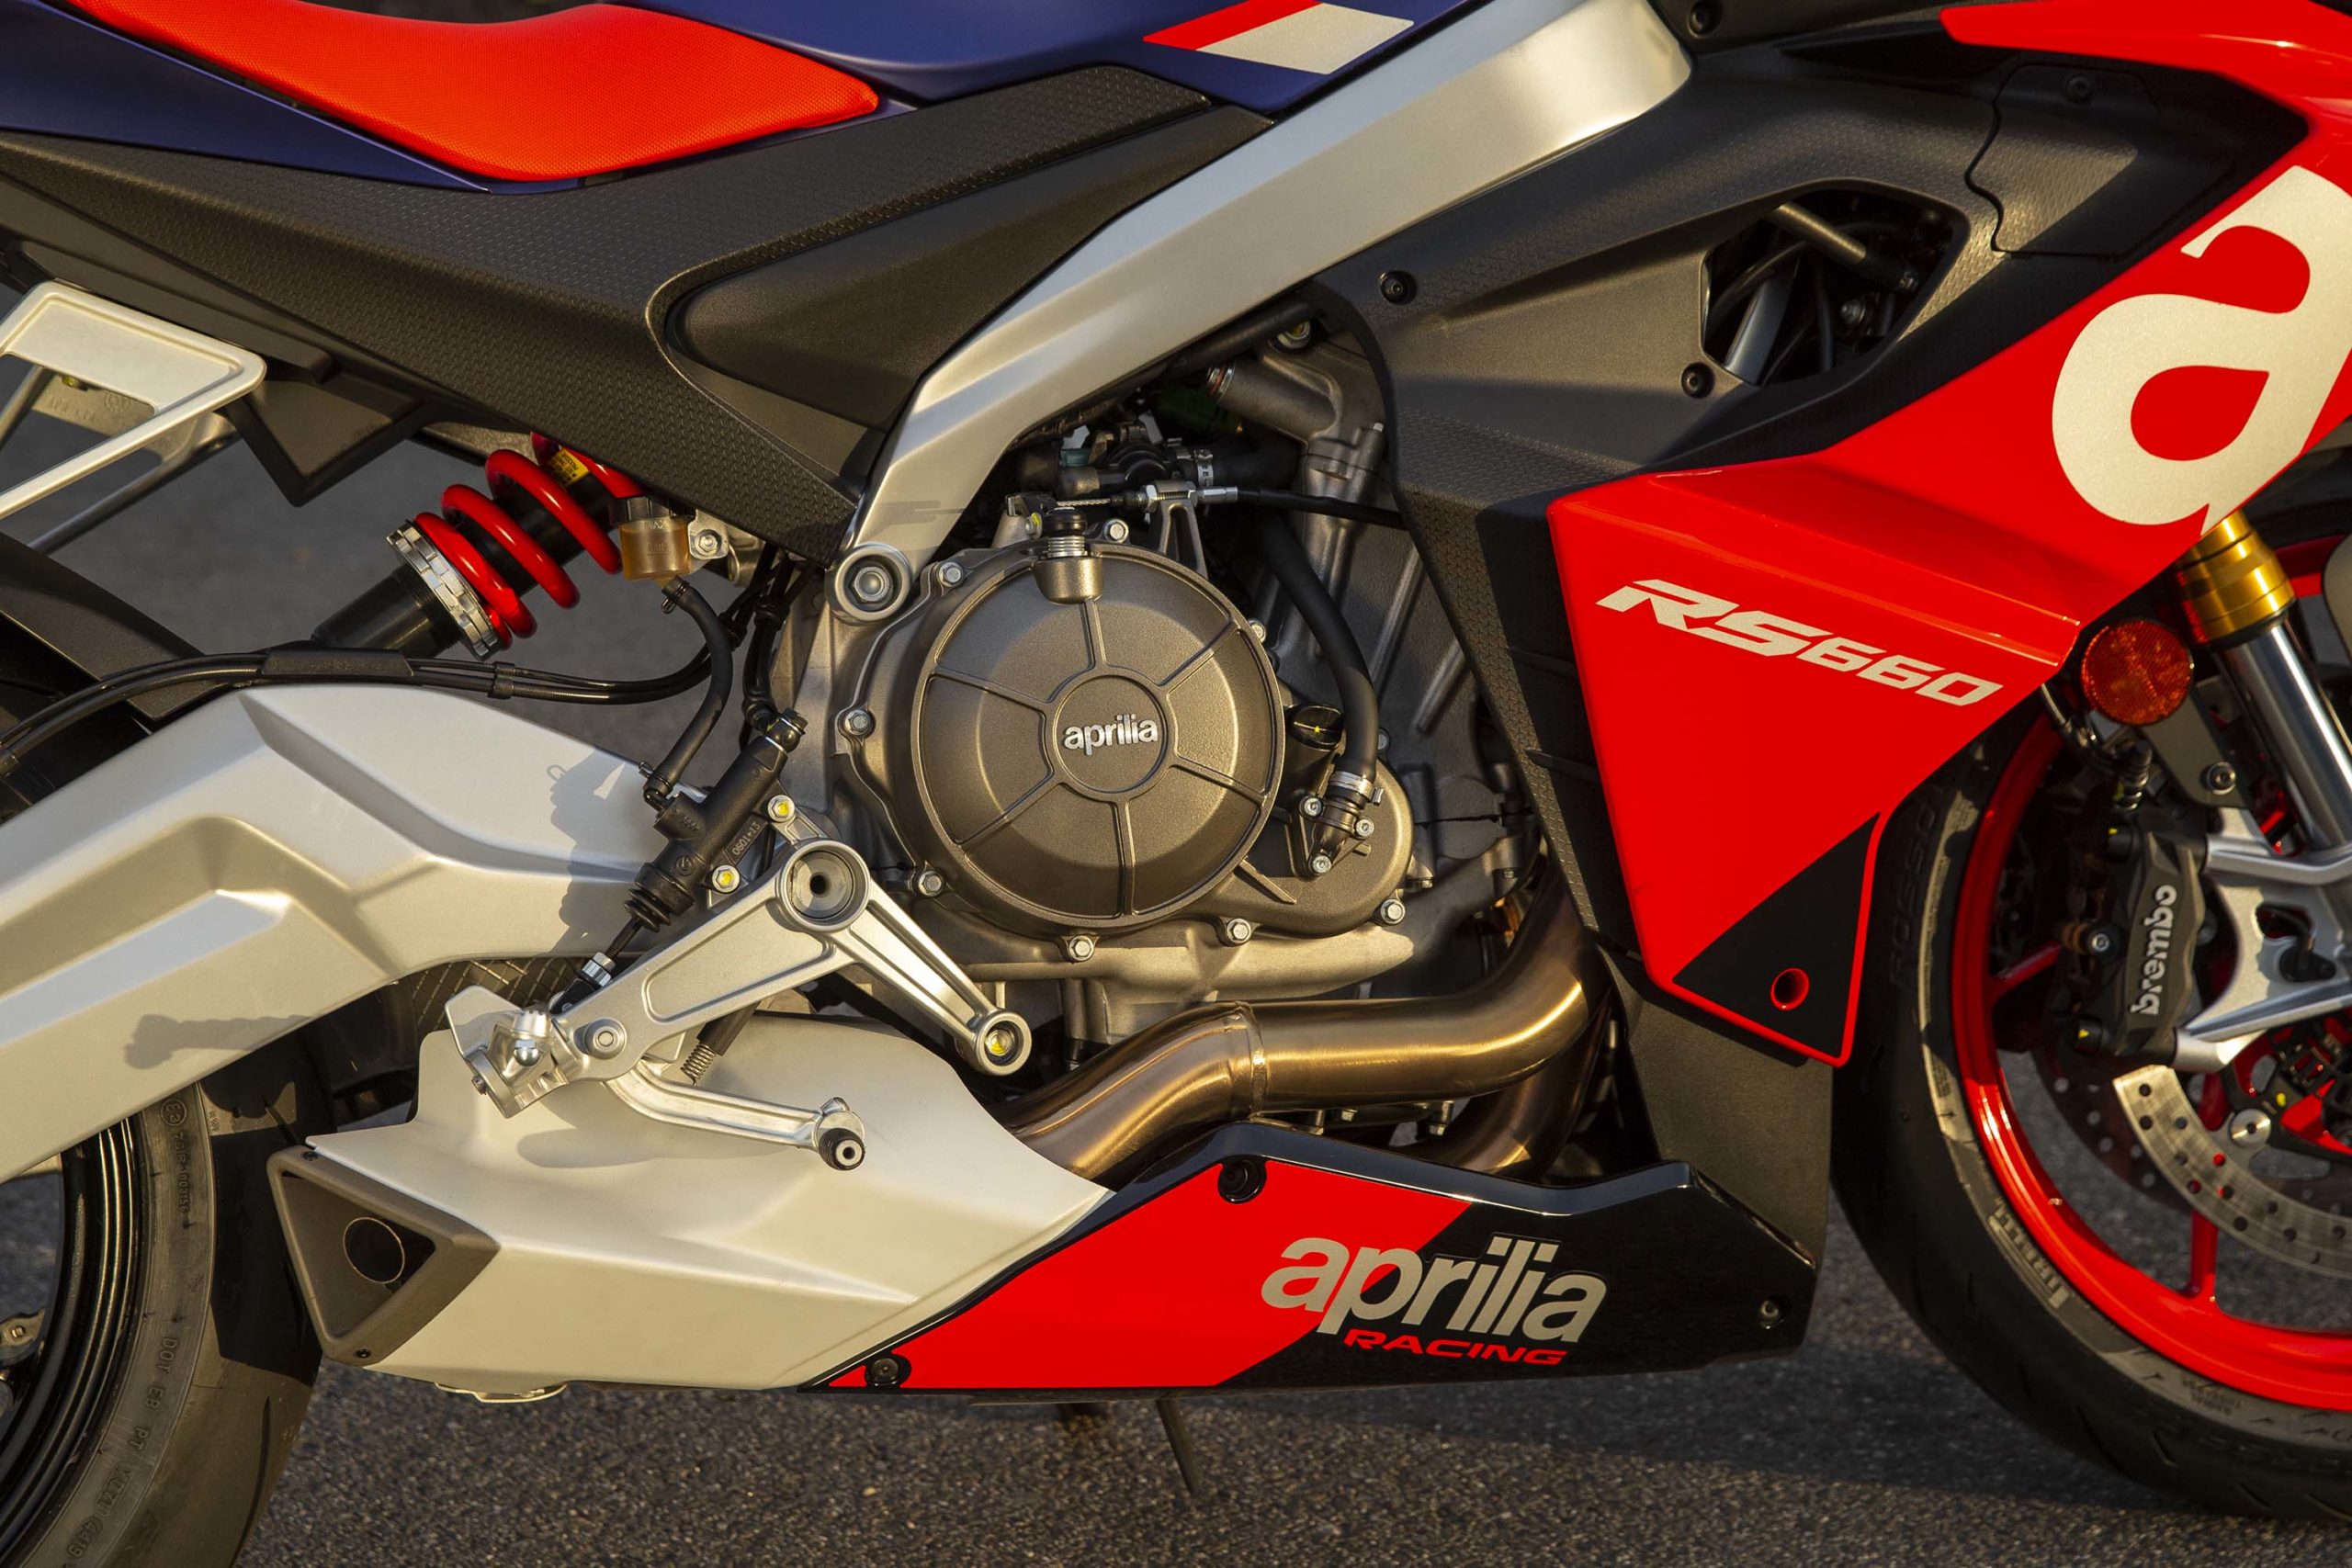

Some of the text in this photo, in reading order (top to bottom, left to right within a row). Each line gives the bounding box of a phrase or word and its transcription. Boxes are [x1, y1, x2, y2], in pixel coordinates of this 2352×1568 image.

[1595, 579, 2004, 706] RS660
[1064, 714, 1159, 755] aprilia
[2130, 885, 2177, 1015] brembo
[1261, 1235, 1608, 1343] aprilia
[156, 1337, 177, 1374] DOT
[1343, 1328, 1567, 1366] RACING
[127, 1425, 150, 1453] PT
